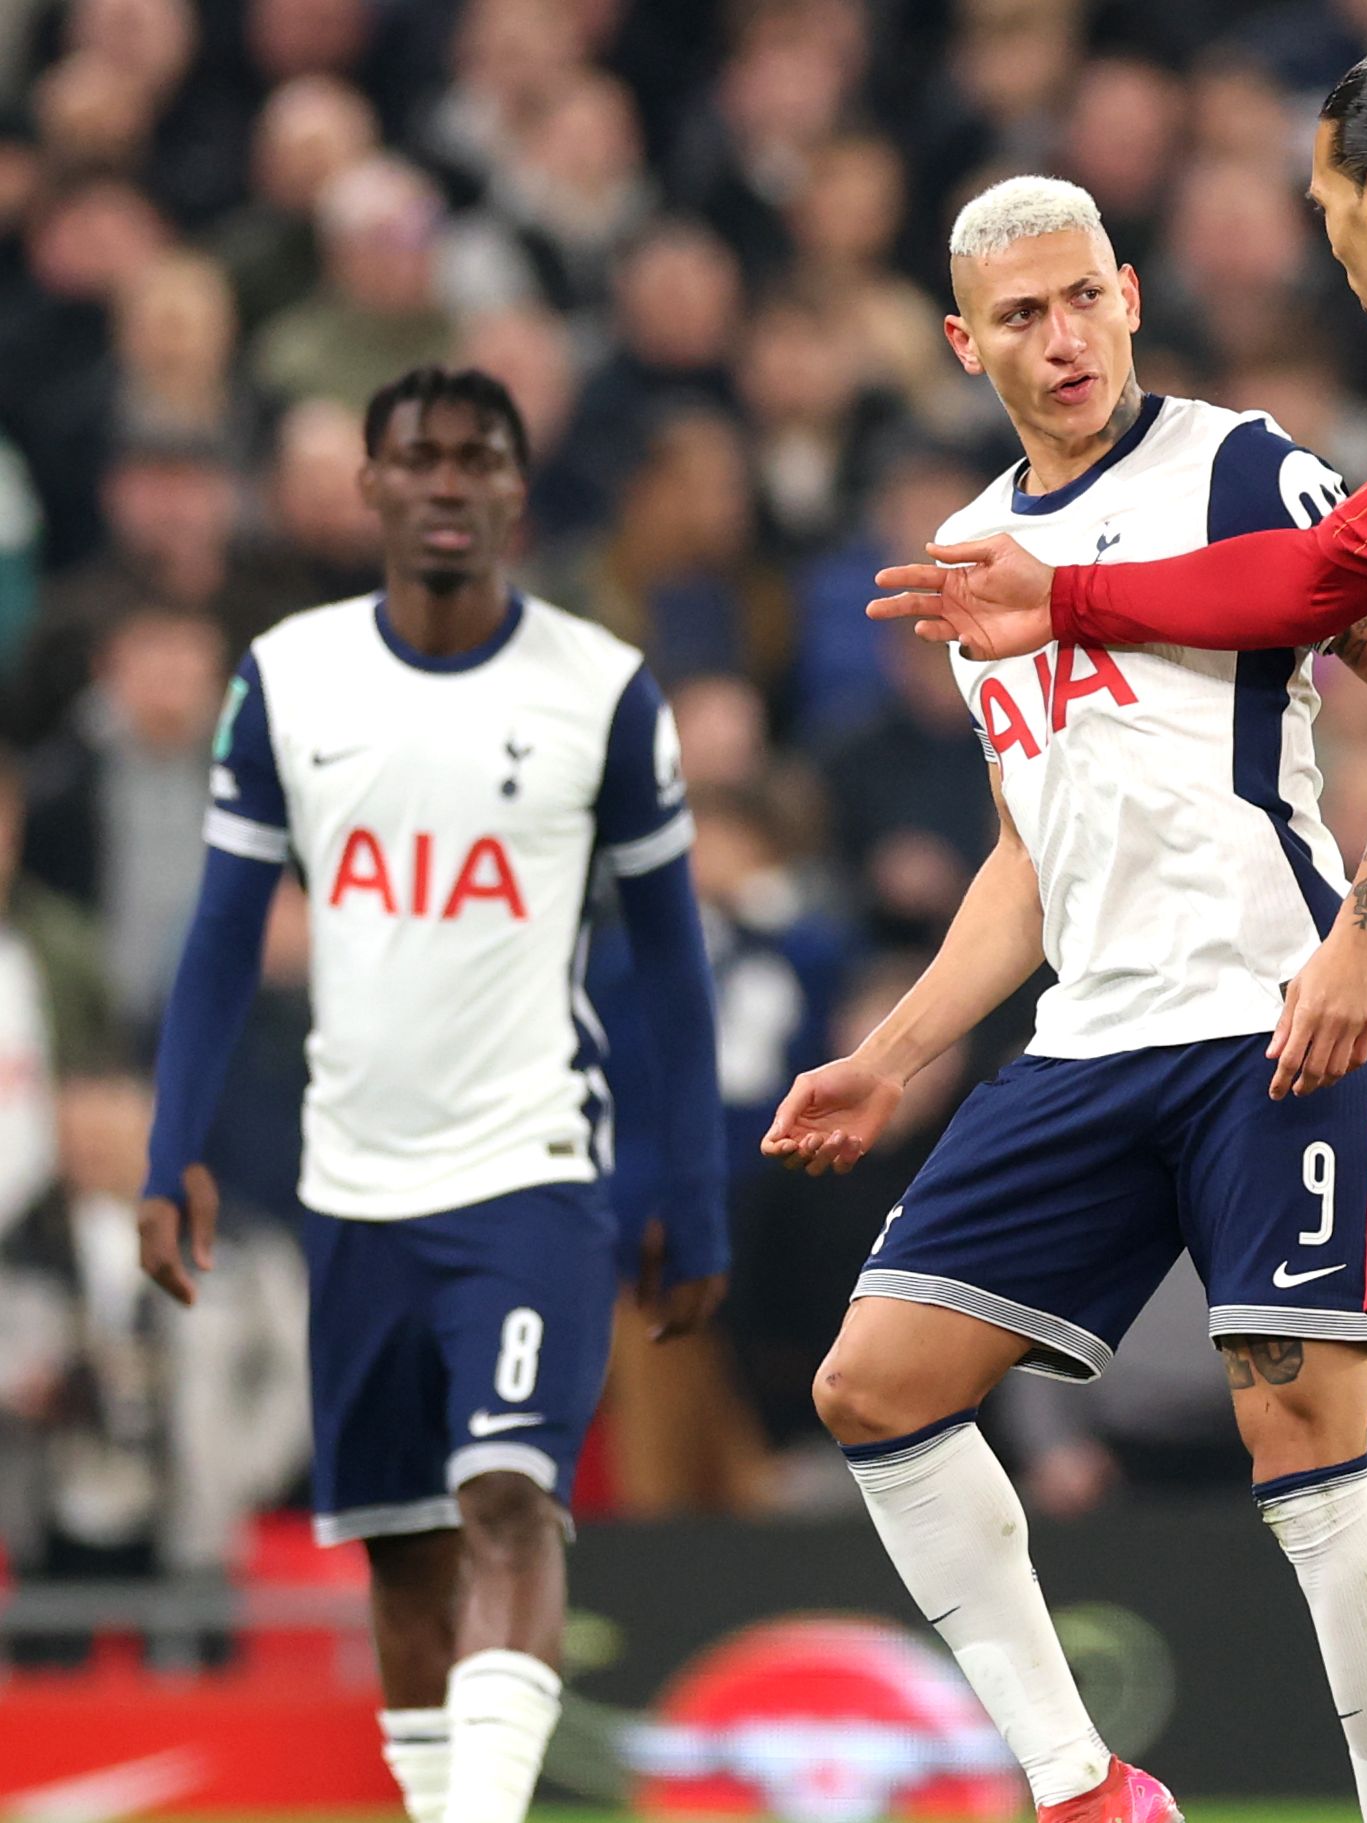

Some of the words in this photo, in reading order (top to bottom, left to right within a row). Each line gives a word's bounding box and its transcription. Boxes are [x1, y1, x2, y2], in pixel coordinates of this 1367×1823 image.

[329, 826, 530, 921] AIA
[1299, 1140, 1336, 1245] 9
[494, 1306, 544, 1403] 8
